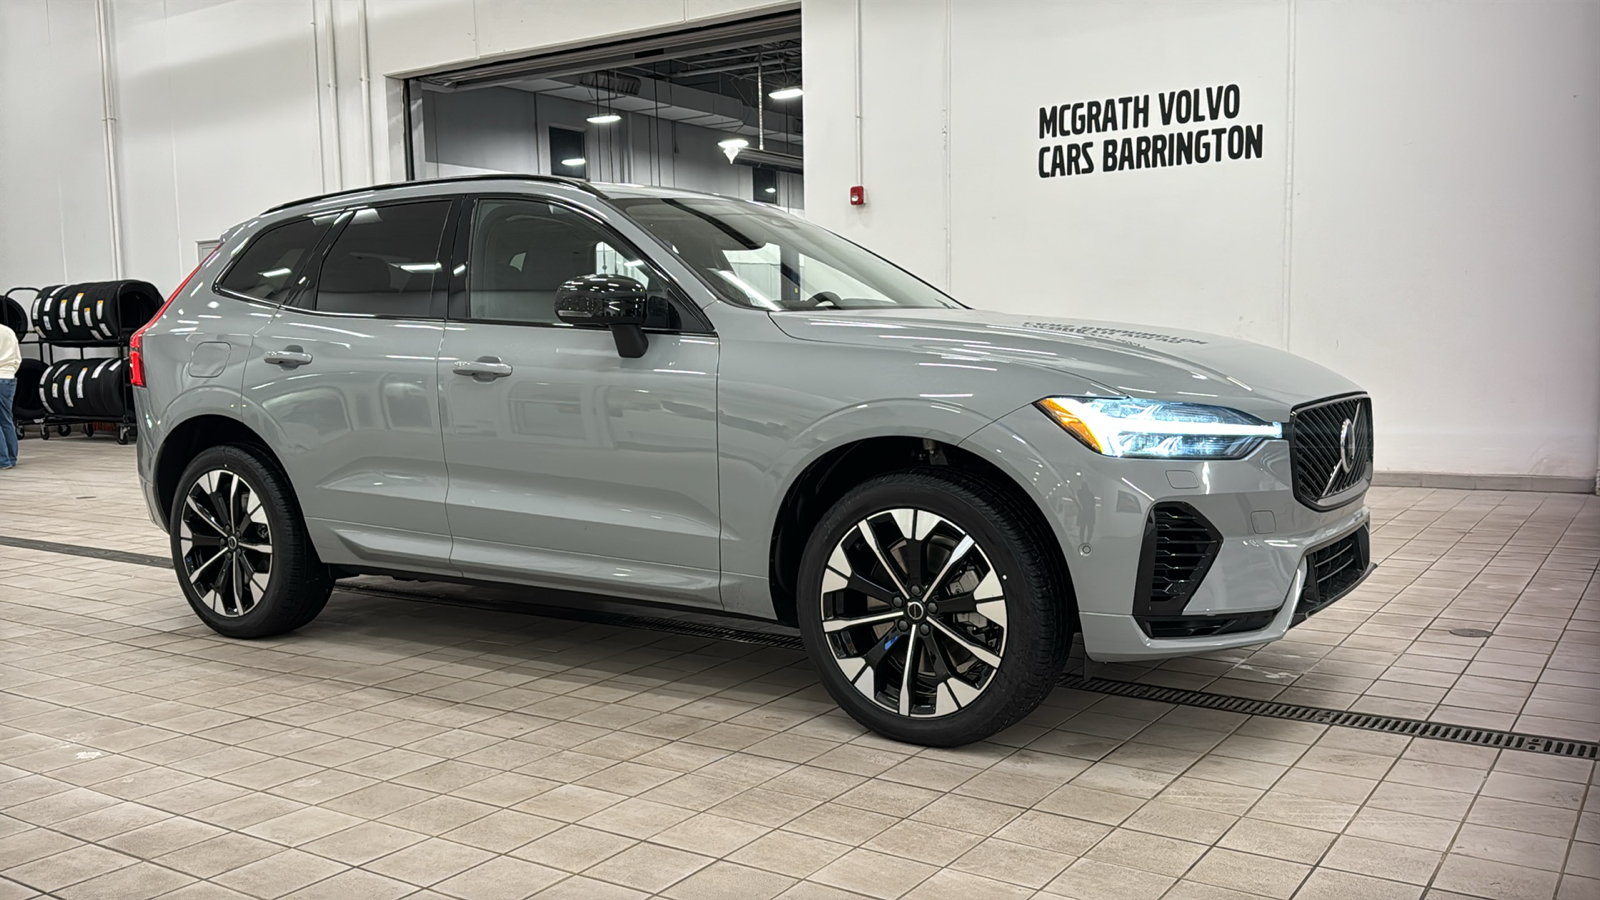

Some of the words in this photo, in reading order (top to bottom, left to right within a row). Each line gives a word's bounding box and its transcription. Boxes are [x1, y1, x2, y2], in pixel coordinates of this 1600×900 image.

[1039, 94, 1150, 139] MCGRATH
[1158, 84, 1241, 126] VOLVO
[1038, 141, 1094, 178] CARS
[1102, 124, 1263, 172] BARRINGTON
